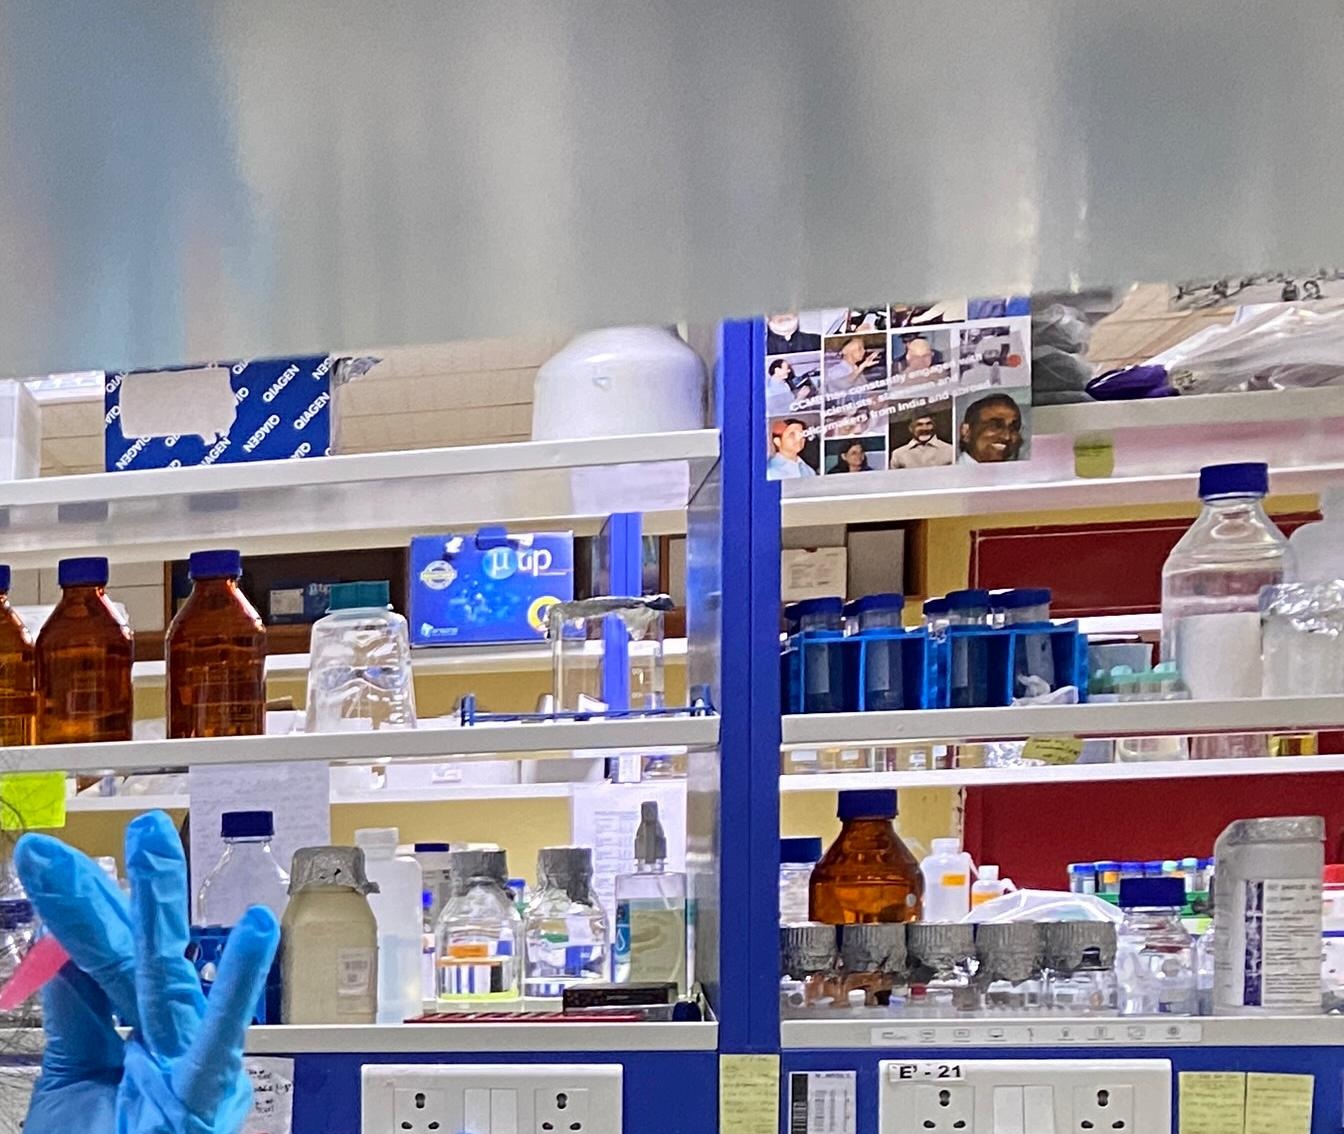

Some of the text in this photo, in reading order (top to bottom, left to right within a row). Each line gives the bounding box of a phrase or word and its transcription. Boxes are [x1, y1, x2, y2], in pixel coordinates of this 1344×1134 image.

[263, 364, 300, 402] QIAGEN
[294, 391, 330, 430] QIAGEN
[870, 404, 897, 420] from
[898, 398, 927, 413] India
[928, 390, 950, 404] and
[243, 414, 280, 453] QIAGEN
[937, 1065, 961, 1078] 21
